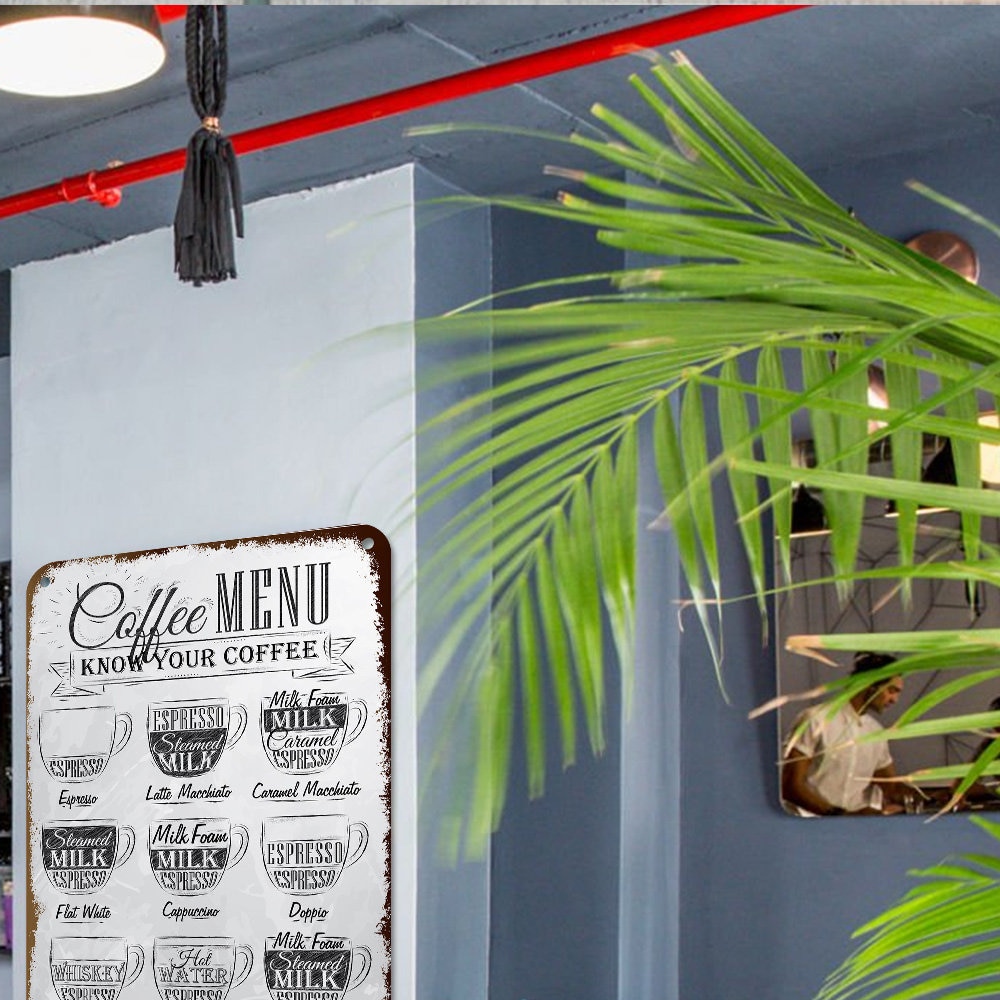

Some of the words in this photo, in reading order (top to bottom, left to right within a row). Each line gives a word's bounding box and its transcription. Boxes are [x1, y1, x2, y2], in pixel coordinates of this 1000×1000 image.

[69, 582, 208, 664] Coffee
[216, 562, 332, 633] MENU
[81, 654, 145, 676] KNOW
[155, 648, 216, 671] YOUR
[223, 640, 319, 664] COFFEE
[269, 690, 301, 708] Milk
[308, 689, 341, 706] Foam
[153, 707, 224, 731] ESPRESSO
[271, 708, 338, 729] MILK
[153, 732, 224, 753] Steamed
[267, 728, 340, 751] Caramel
[49, 758, 104, 778] ESPRESSO
[157, 751, 216, 772] MILK
[272, 748, 335, 769] ESPRESSO
[59, 789, 98, 809] Espresso
[145, 785, 172, 800] Latte
[178, 783, 232, 799] Macchiato
[252, 781, 300, 798] Caramel
[303, 780, 361, 796] Macchiato
[46, 828, 113, 849] Steamed
[152, 823, 189, 844] Milk
[191, 823, 229, 844] Foam
[50, 848, 110, 868] MILK
[158, 849, 221, 868] MILK
[267, 842, 343, 865] ESPRESSO
[52, 870, 107, 889] ESPRESSO
[160, 871, 218, 890] ESPRESSO
[274, 870, 336, 890] ESPRESSO
[56, 903, 80, 919] Flat
[82, 903, 112, 919] White
[162, 901, 220, 922] Cappuccino
[289, 902, 329, 923] Doppio
[273, 931, 306, 949] Milk
[312, 932, 344, 949] Foam
[170, 948, 212, 968] Hot
[269, 951, 344, 971] Steamed
[52, 961, 126, 982] WHISKEY
[157, 967, 228, 984] WATER
[273, 969, 341, 989] MILK
